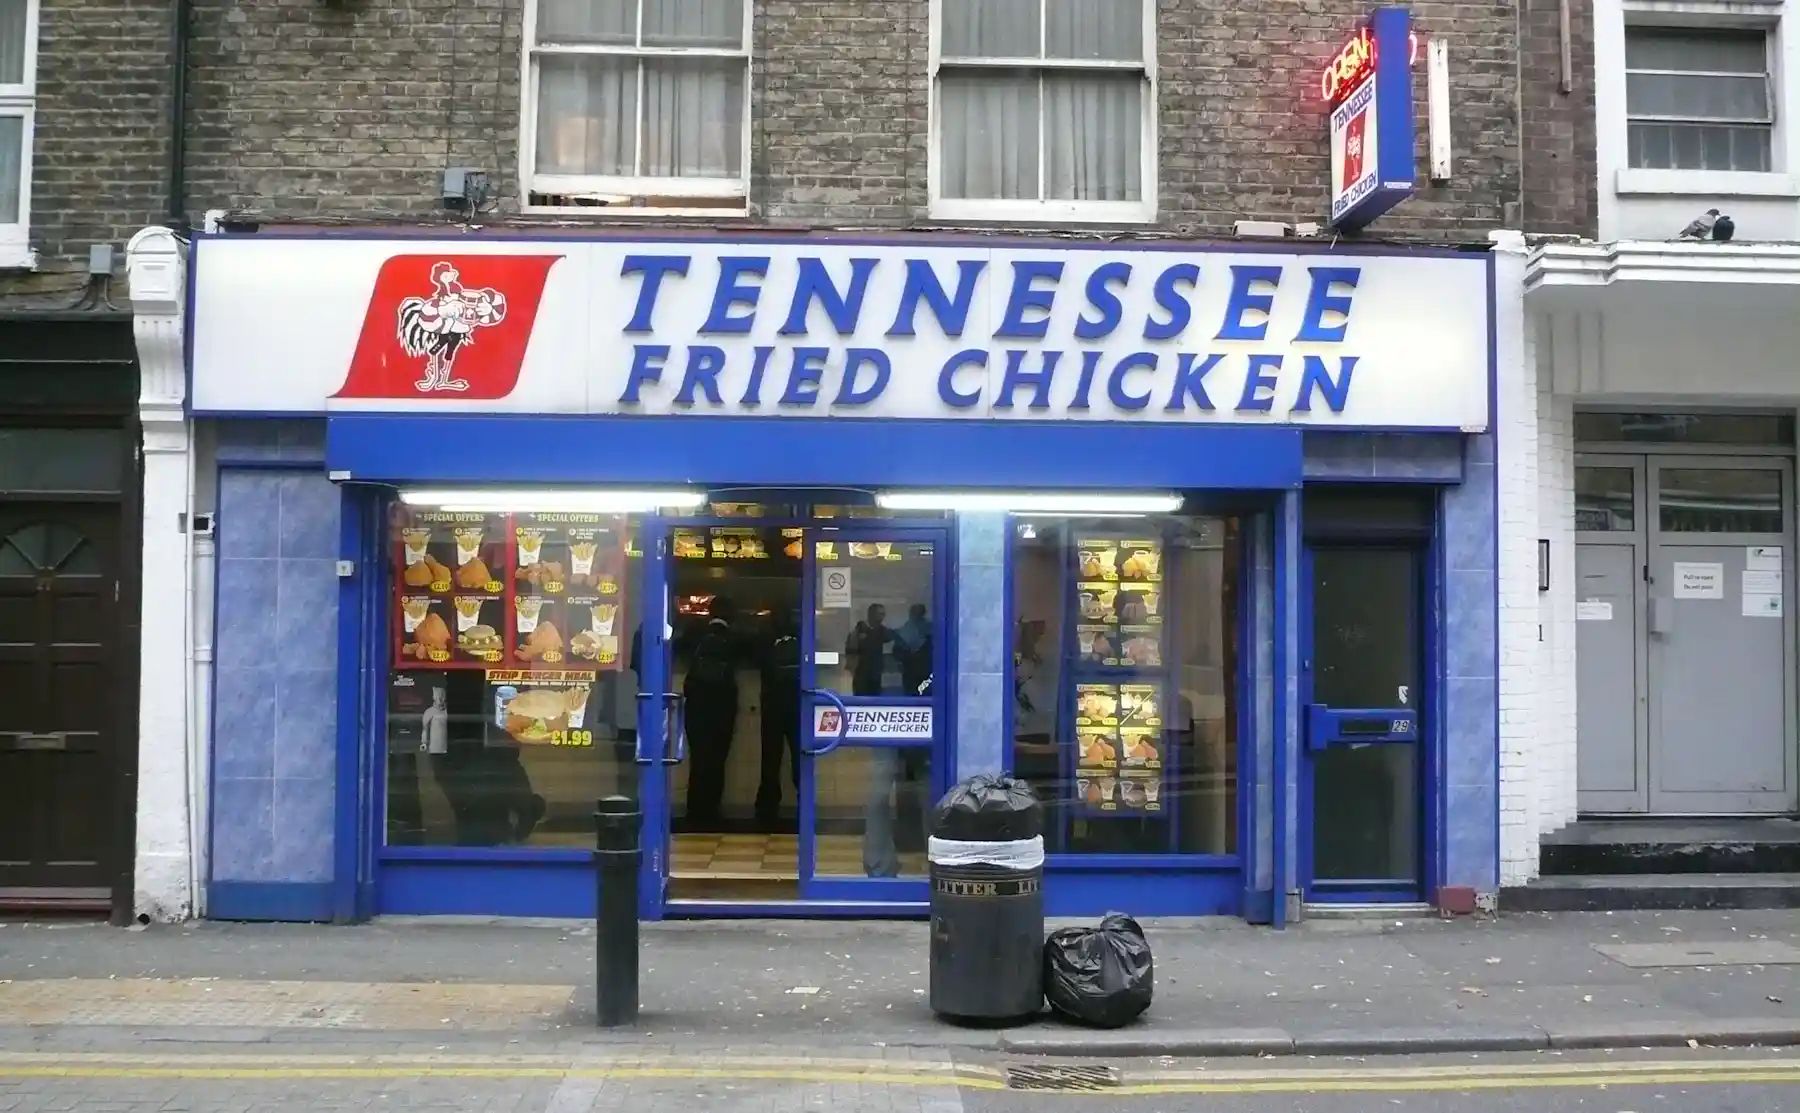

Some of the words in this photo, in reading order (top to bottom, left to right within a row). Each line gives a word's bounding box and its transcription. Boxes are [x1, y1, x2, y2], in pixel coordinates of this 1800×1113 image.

[1322, 27, 1369, 100] OPEN
[1334, 80, 1373, 134] TENNESSEE
[1333, 193, 1349, 217] FRIED
[1351, 170, 1377, 201] CHICKEN
[620, 254, 1361, 343] TENNESSEE
[617, 344, 892, 406] FRIED
[937, 348, 1361, 412] CHICKEN
[423, 513, 455, 522] SPECIAL
[455, 513, 485, 522] OFFERS
[537, 514, 568, 522] SPECIAL
[569, 514, 599, 523] OFFERS
[488, 671, 518, 679] STRIP
[521, 671, 562, 680] BURGER
[564, 672, 592, 680] MEAL
[847, 712, 930, 723] TENNESSEE
[847, 724, 877, 732] FRIED
[880, 724, 929, 732] CHICKEN
[1394, 720, 1408, 732] 29
[551, 730, 593, 746] £1.99
[937, 880, 998, 896] LITTER
